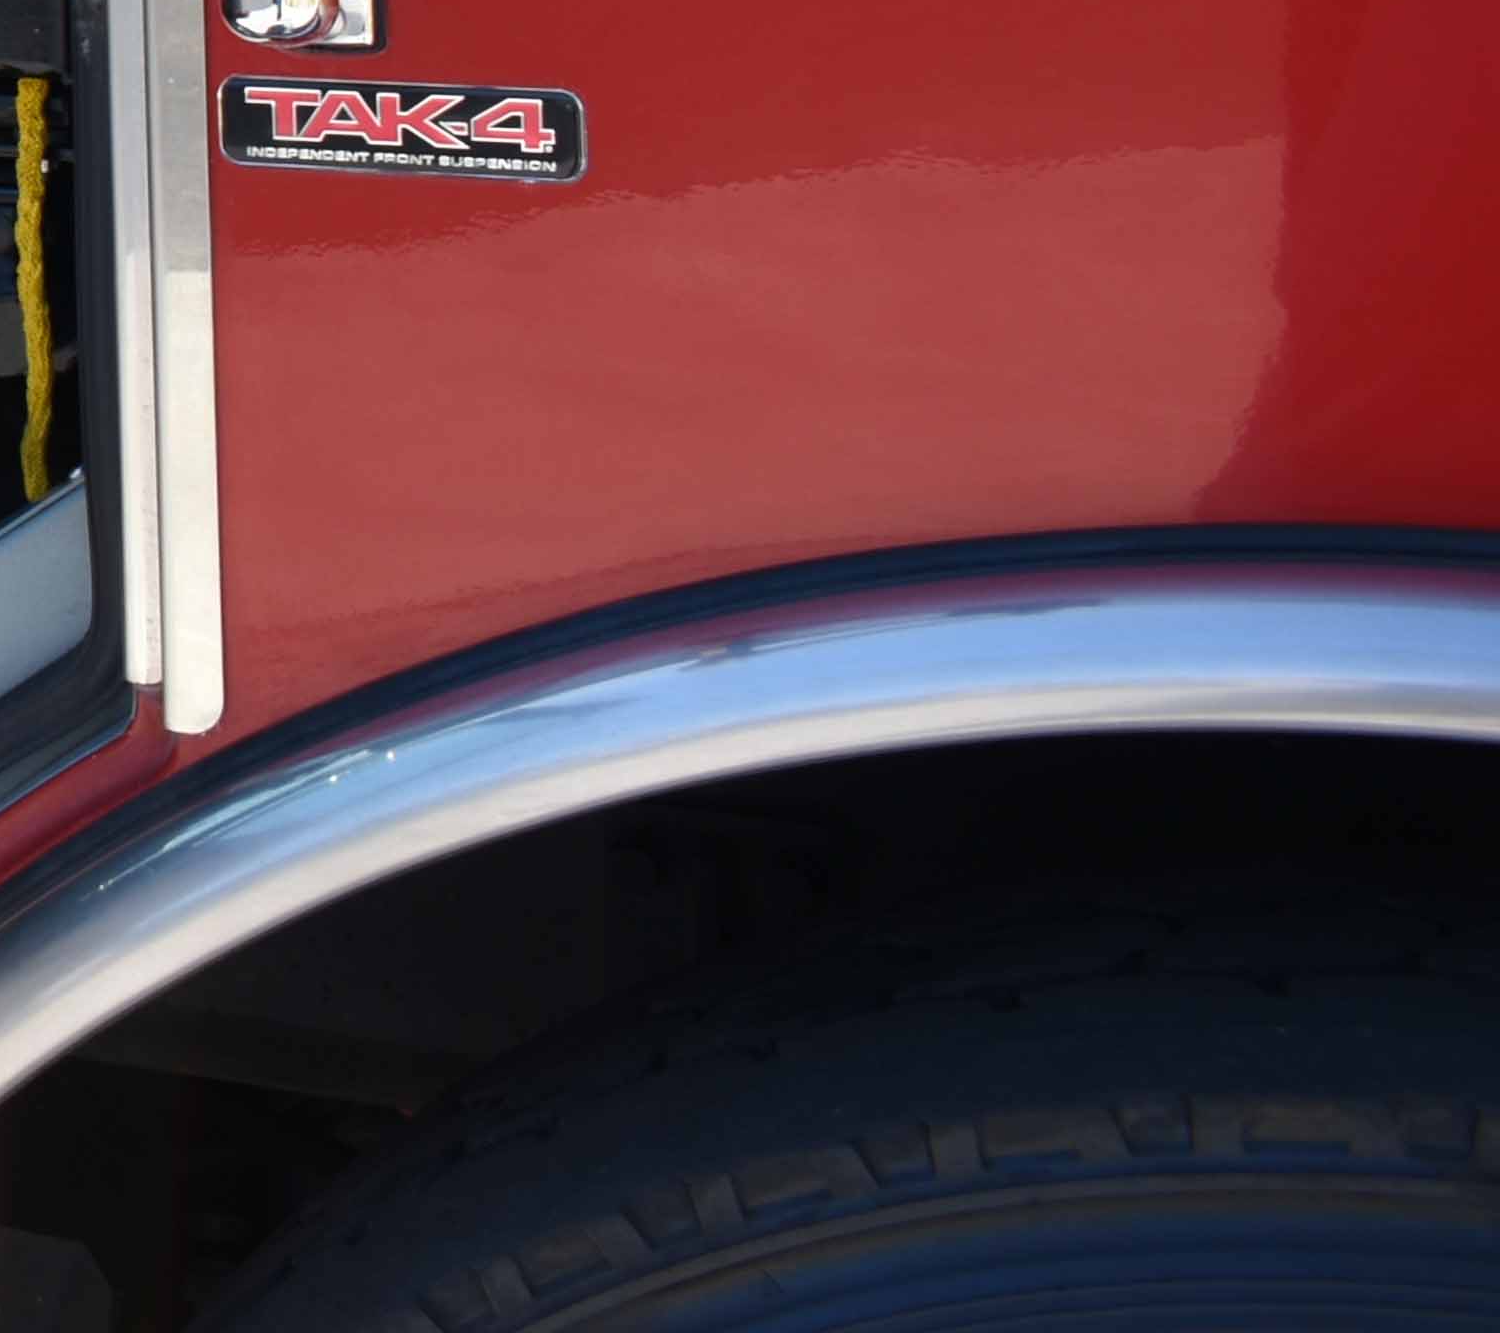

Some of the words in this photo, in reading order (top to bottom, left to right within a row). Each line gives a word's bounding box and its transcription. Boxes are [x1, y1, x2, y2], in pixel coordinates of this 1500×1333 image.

[244, 86, 555, 154] TAK-4
[247, 146, 370, 164] INDEPENDENT
[373, 151, 435, 167] FRONT
[438, 155, 557, 172] SUSPENSION
